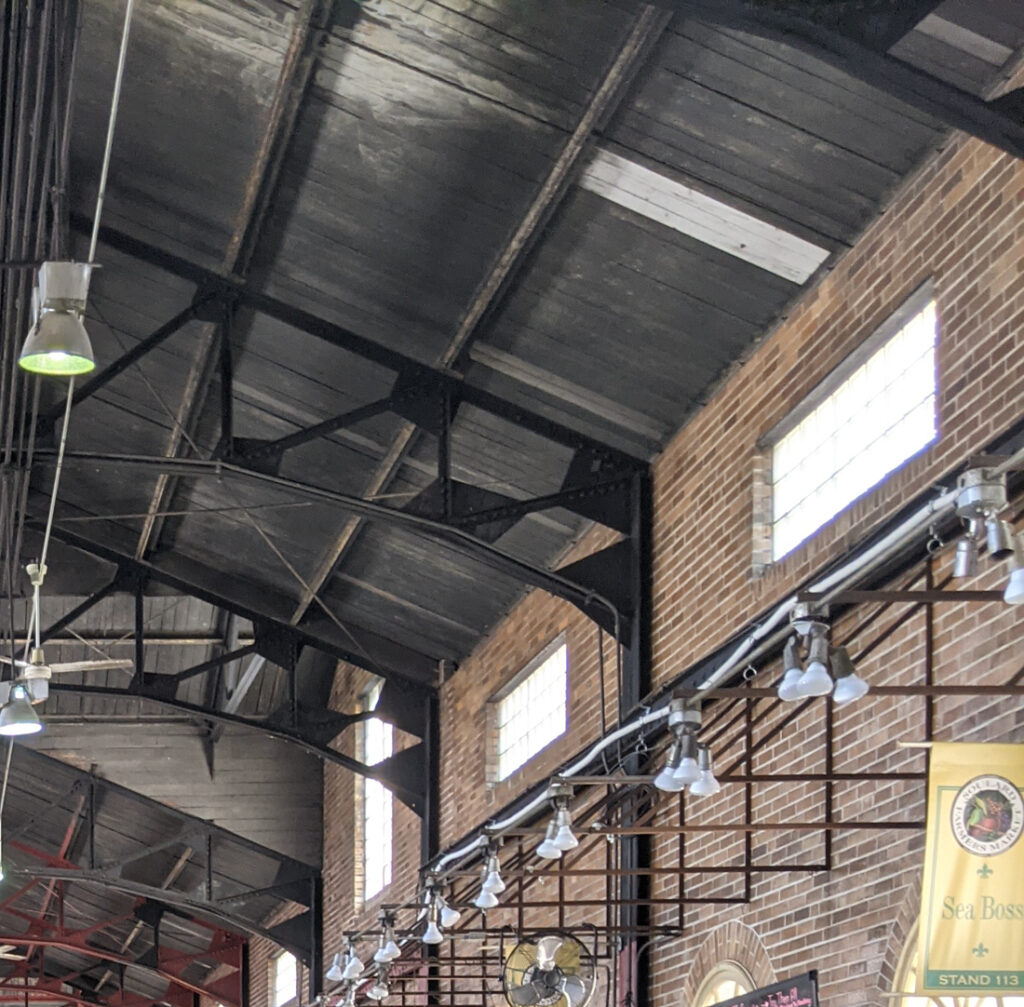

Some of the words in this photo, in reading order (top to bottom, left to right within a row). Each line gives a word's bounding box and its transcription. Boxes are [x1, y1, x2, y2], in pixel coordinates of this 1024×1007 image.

[962, 780, 1017, 801] SOULARD
[989, 810, 1021, 849] MARKET
[941, 896, 974, 921] Sea
[938, 974, 991, 986] STAND
[996, 975, 1020, 986] 113
